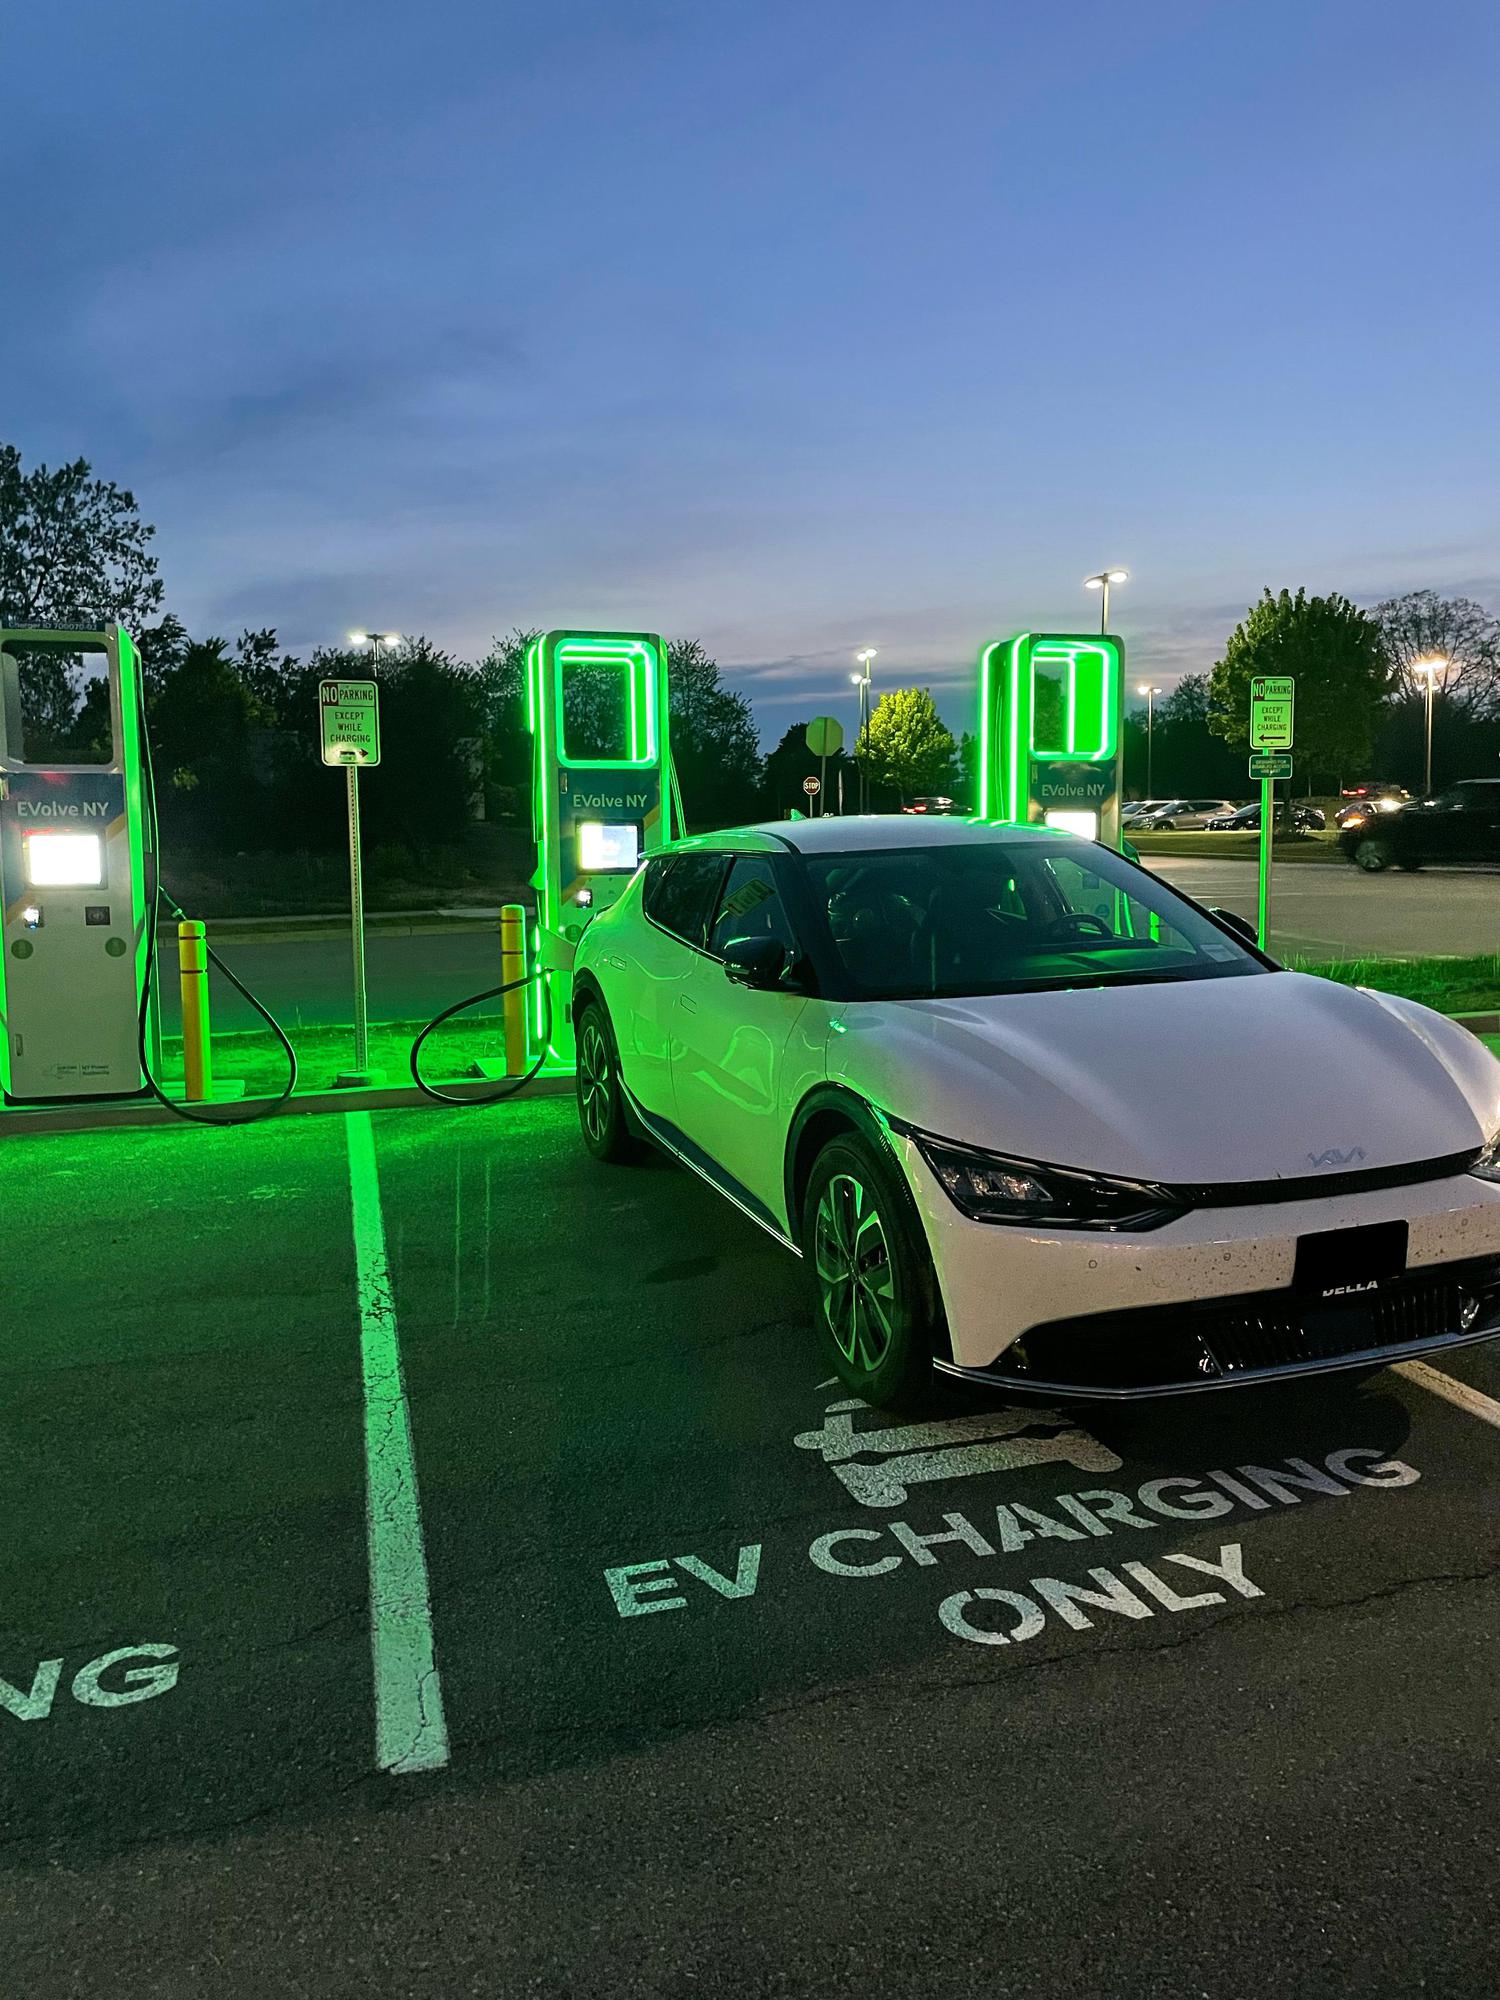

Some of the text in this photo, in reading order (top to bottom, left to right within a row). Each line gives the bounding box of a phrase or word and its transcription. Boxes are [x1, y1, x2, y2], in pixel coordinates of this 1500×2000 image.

[322, 686, 374, 702] NO PARKING
[1253, 683, 1264, 697] NO
[335, 711, 364, 720] EXCEPT
[1262, 706, 1283, 714] EXCEPT
[338, 723, 362, 732] WHILE
[1257, 723, 1287, 731] CHARGING
[330, 734, 371, 743] CHARGING
[805, 782, 819, 790] STOP
[1041, 783, 1105, 797] EVolve NY
[573, 794, 648, 808] EVolve NY
[17, 801, 109, 817] EVolve NY
[603, 1448, 1421, 1618] EV CHARGING
[938, 1543, 1266, 1645] ONLY
